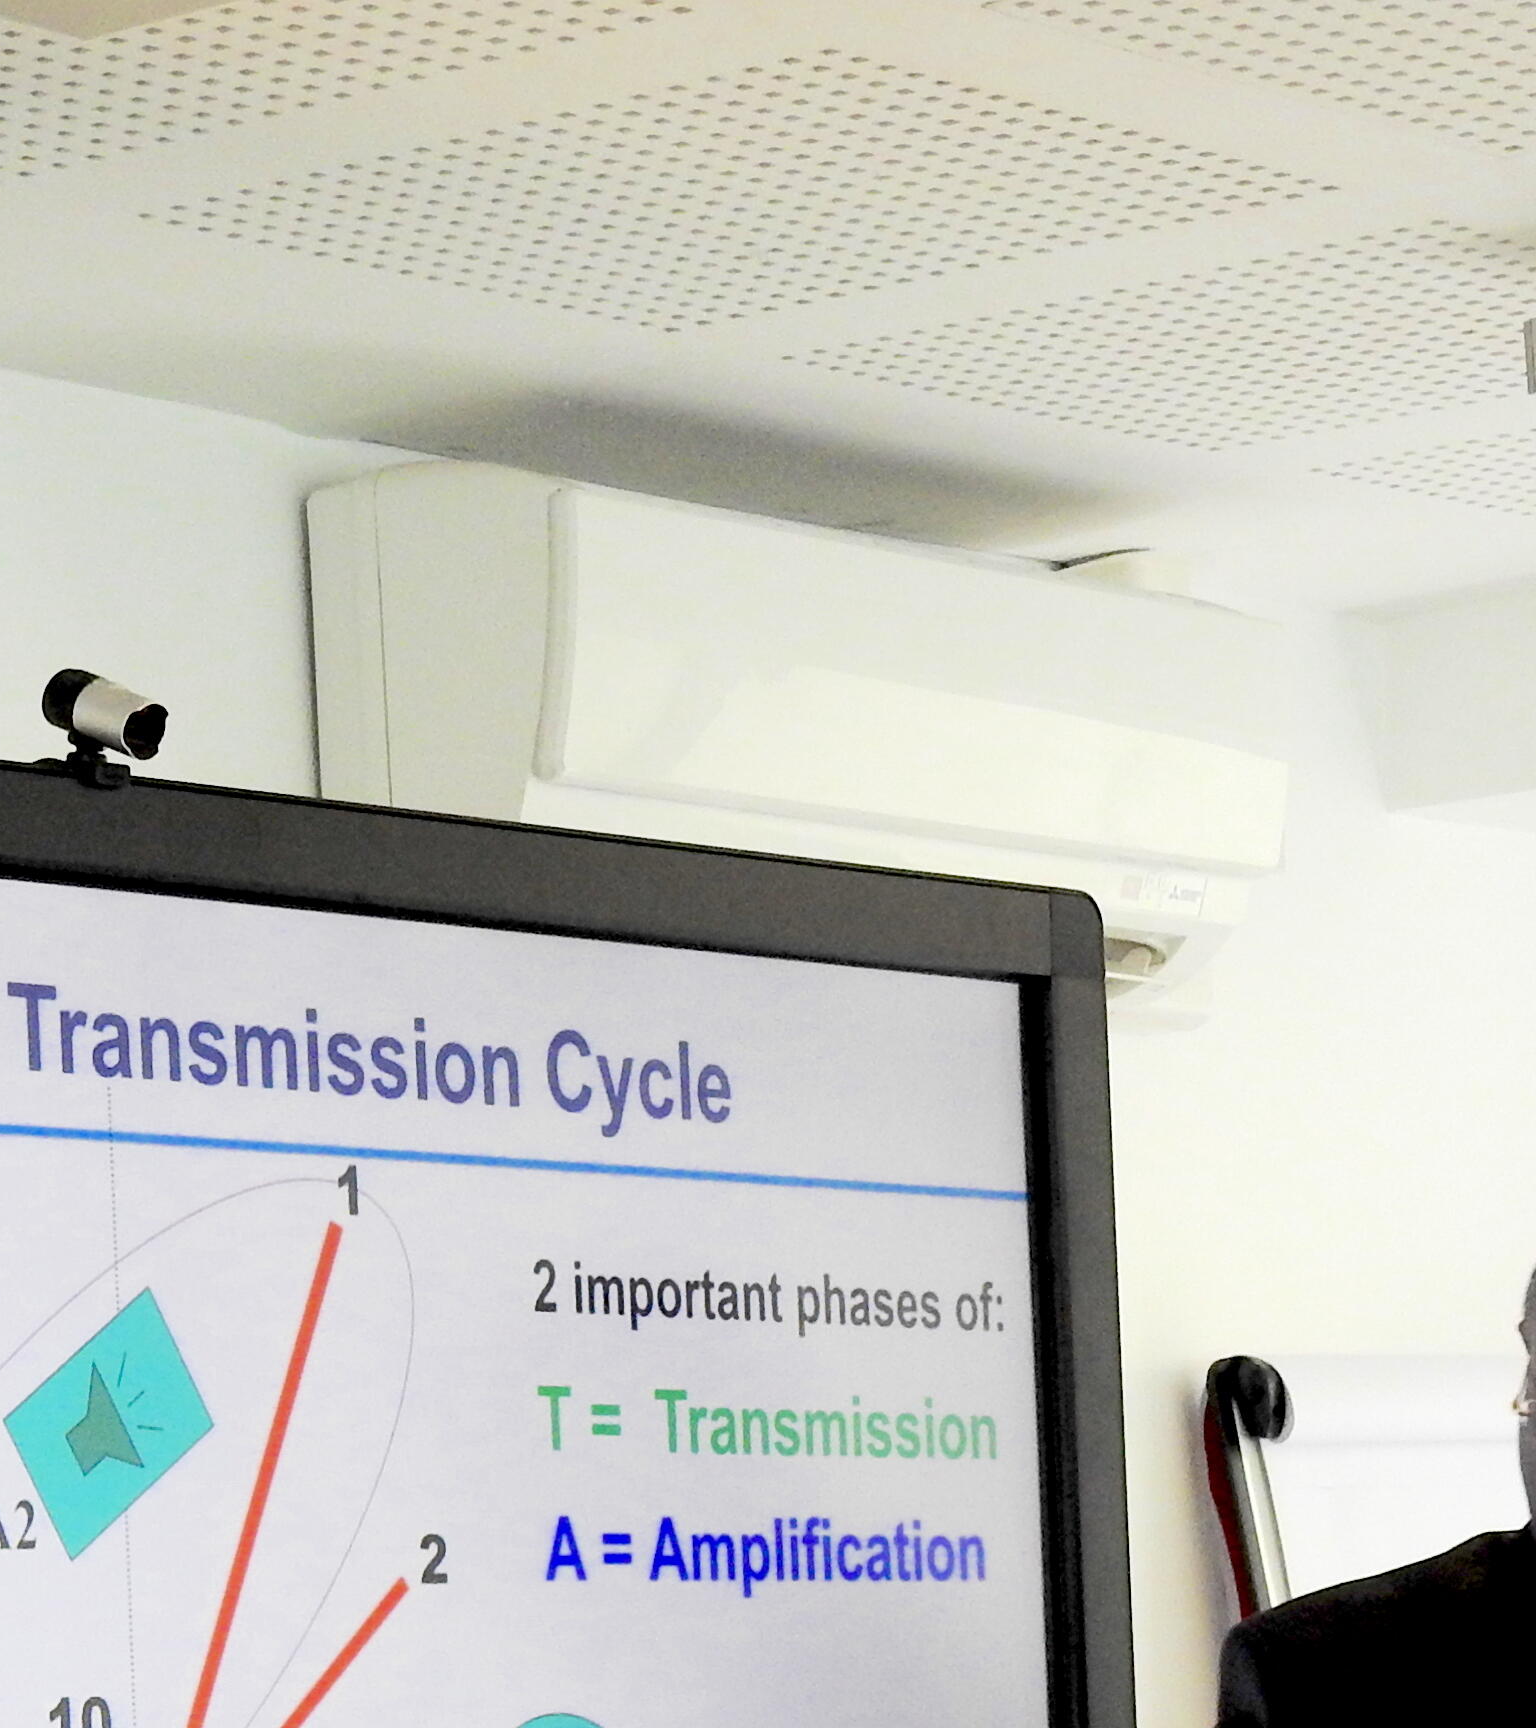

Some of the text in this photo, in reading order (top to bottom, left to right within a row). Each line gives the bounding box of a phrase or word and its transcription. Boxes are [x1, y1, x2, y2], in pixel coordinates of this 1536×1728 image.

[6, 981, 520, 1107] Transmission
[546, 1029, 733, 1138] Cycle
[337, 1164, 359, 1215] 1
[533, 1259, 1004, 1337] 2 important phases of:
[537, 1386, 997, 1459] T = Transmission
[420, 1534, 448, 1584] 2
[546, 1516, 986, 1598] A = Amplification
